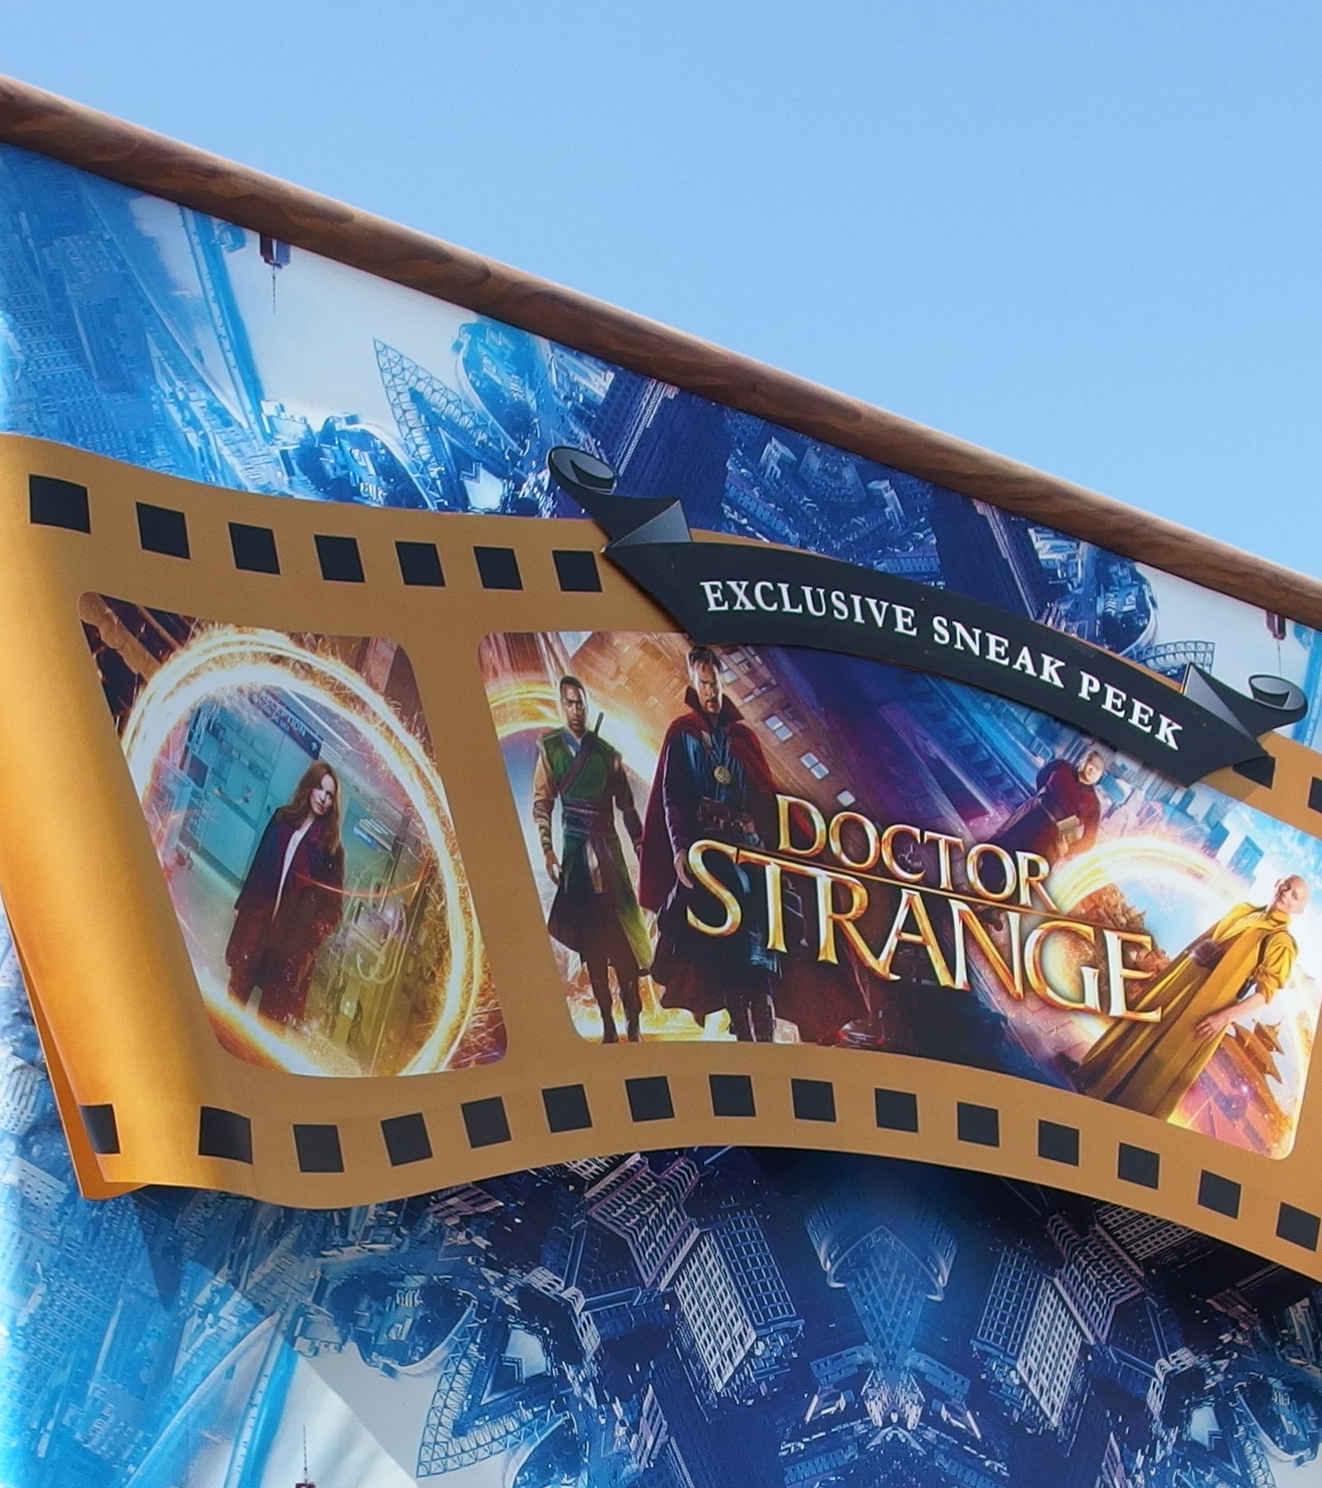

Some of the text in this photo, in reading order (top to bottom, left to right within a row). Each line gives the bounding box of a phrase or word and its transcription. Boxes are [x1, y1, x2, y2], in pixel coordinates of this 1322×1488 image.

[699, 579, 1184, 752] EXCLUSIVE SNEAK PEEK
[685, 837, 1164, 1024] STRANGE
[774, 792, 1061, 915] DOCTOR
